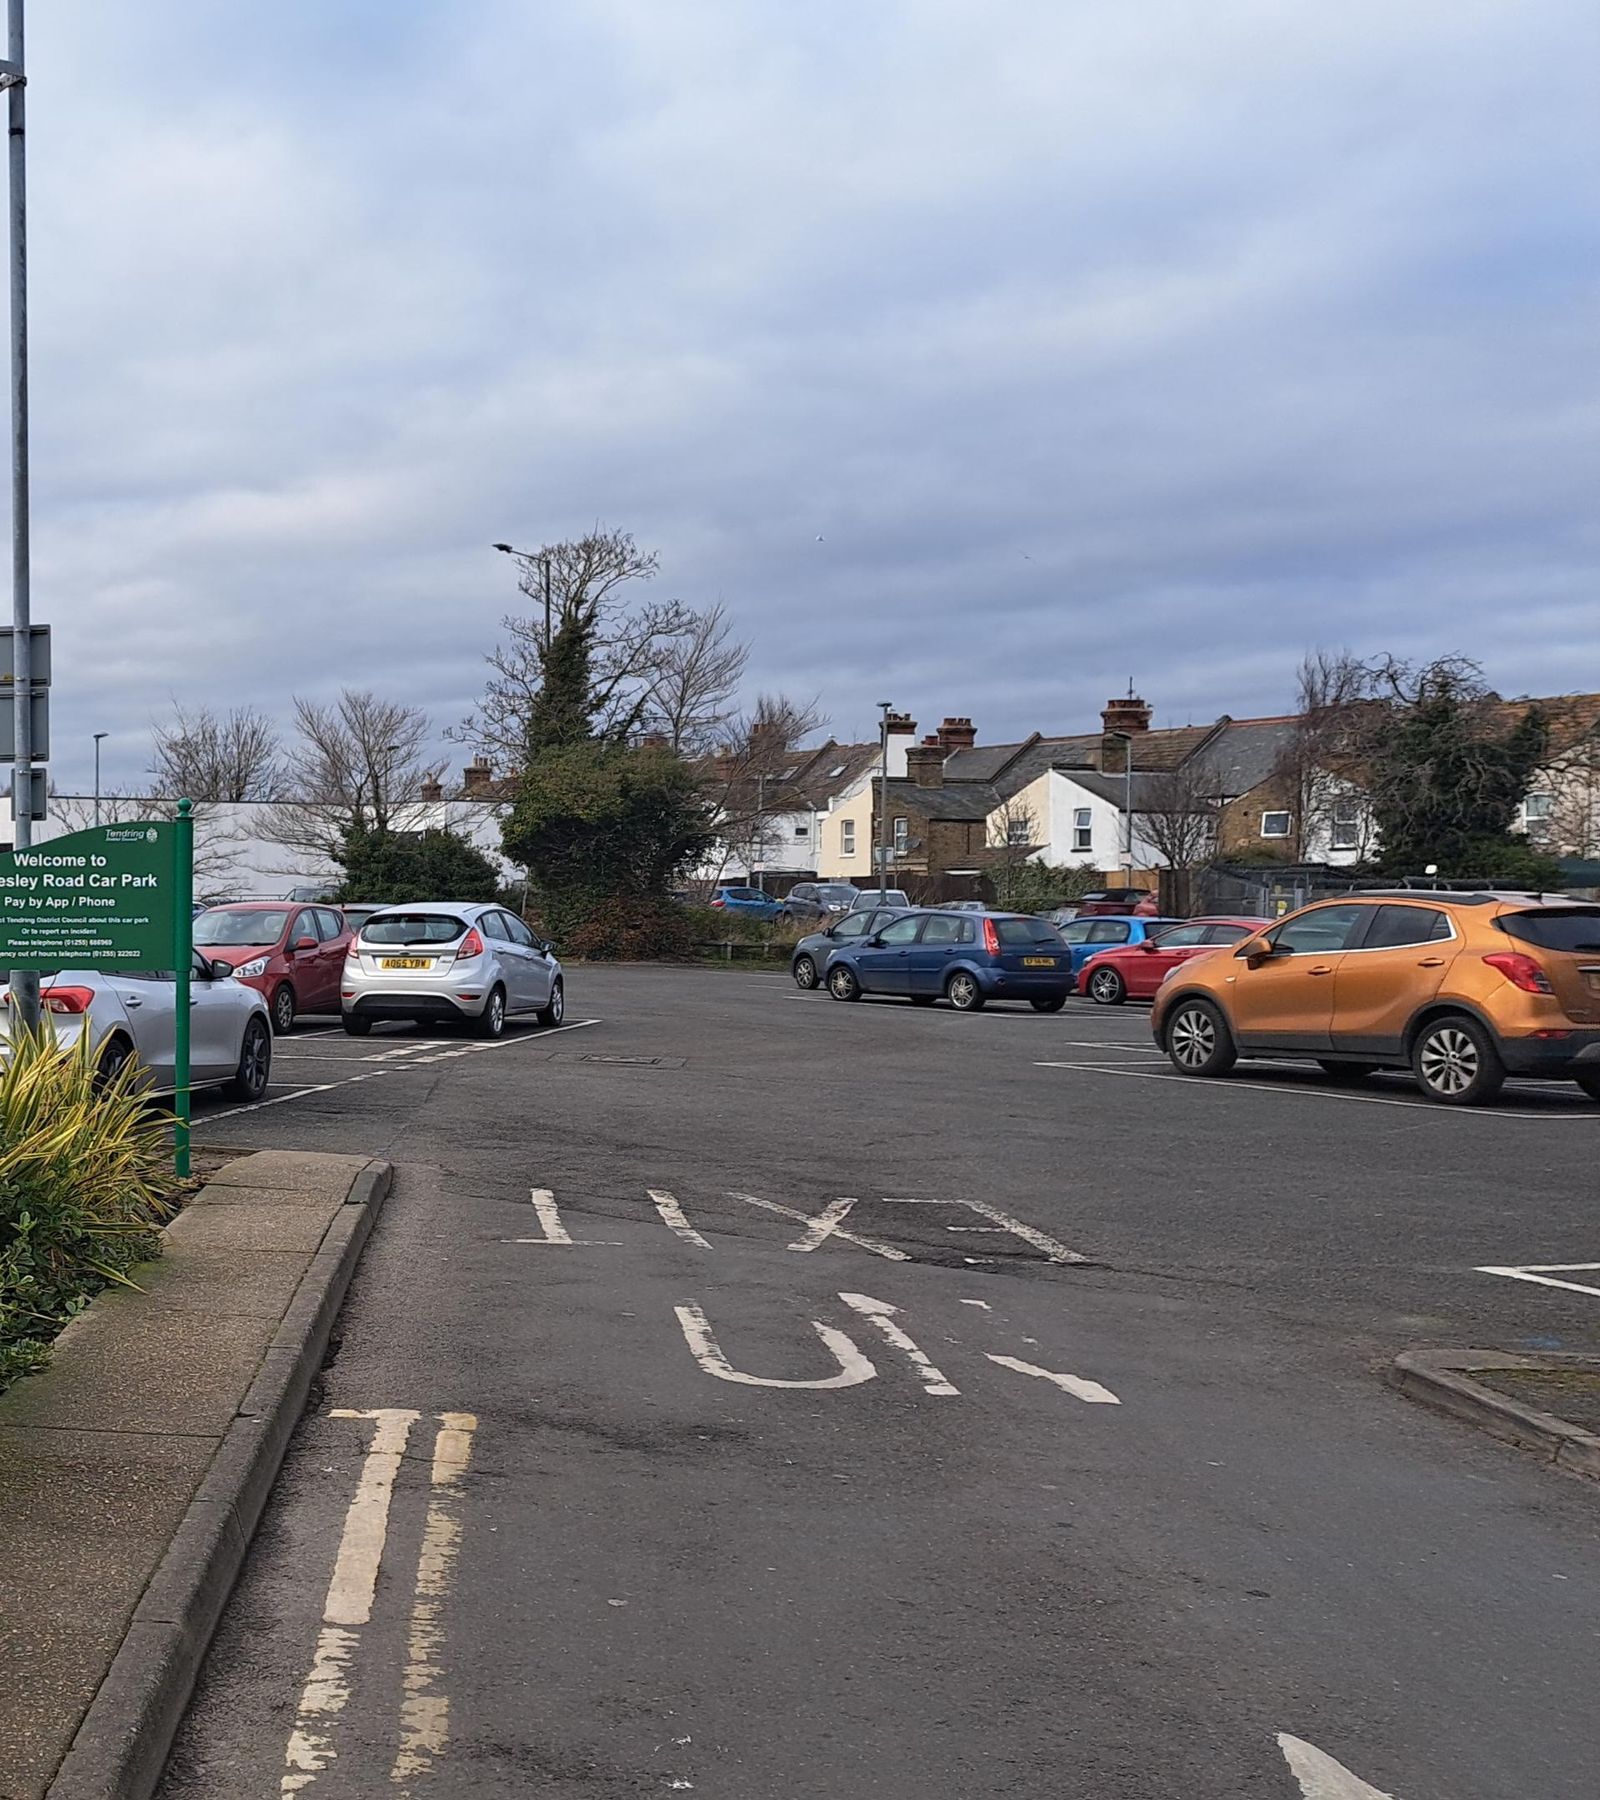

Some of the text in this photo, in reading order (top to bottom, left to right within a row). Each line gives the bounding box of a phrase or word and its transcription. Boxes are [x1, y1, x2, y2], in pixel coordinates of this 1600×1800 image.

[105, 828, 145, 839] Tendring
[13, 853, 107, 867] Welcome to
[43, 873, 84, 887] Road
[88, 873, 118, 887] Car
[121, 873, 158, 887] Park
[4, 896, 116, 909] Pay by App / Phone
[6, 916, 36, 925] Tendring
[36, 916, 61, 924] District
[61, 916, 87, 924] Council
[88, 916, 107, 924] about
[108, 916, 121, 924] this
[134, 916, 149, 925] park
[39, 928, 60, 936] report
[30, 939, 63, 947] telephone
[64, 939, 88, 947] (01255)
[59, 950, 91, 959] telephone
[92, 950, 117, 959] (01255)
